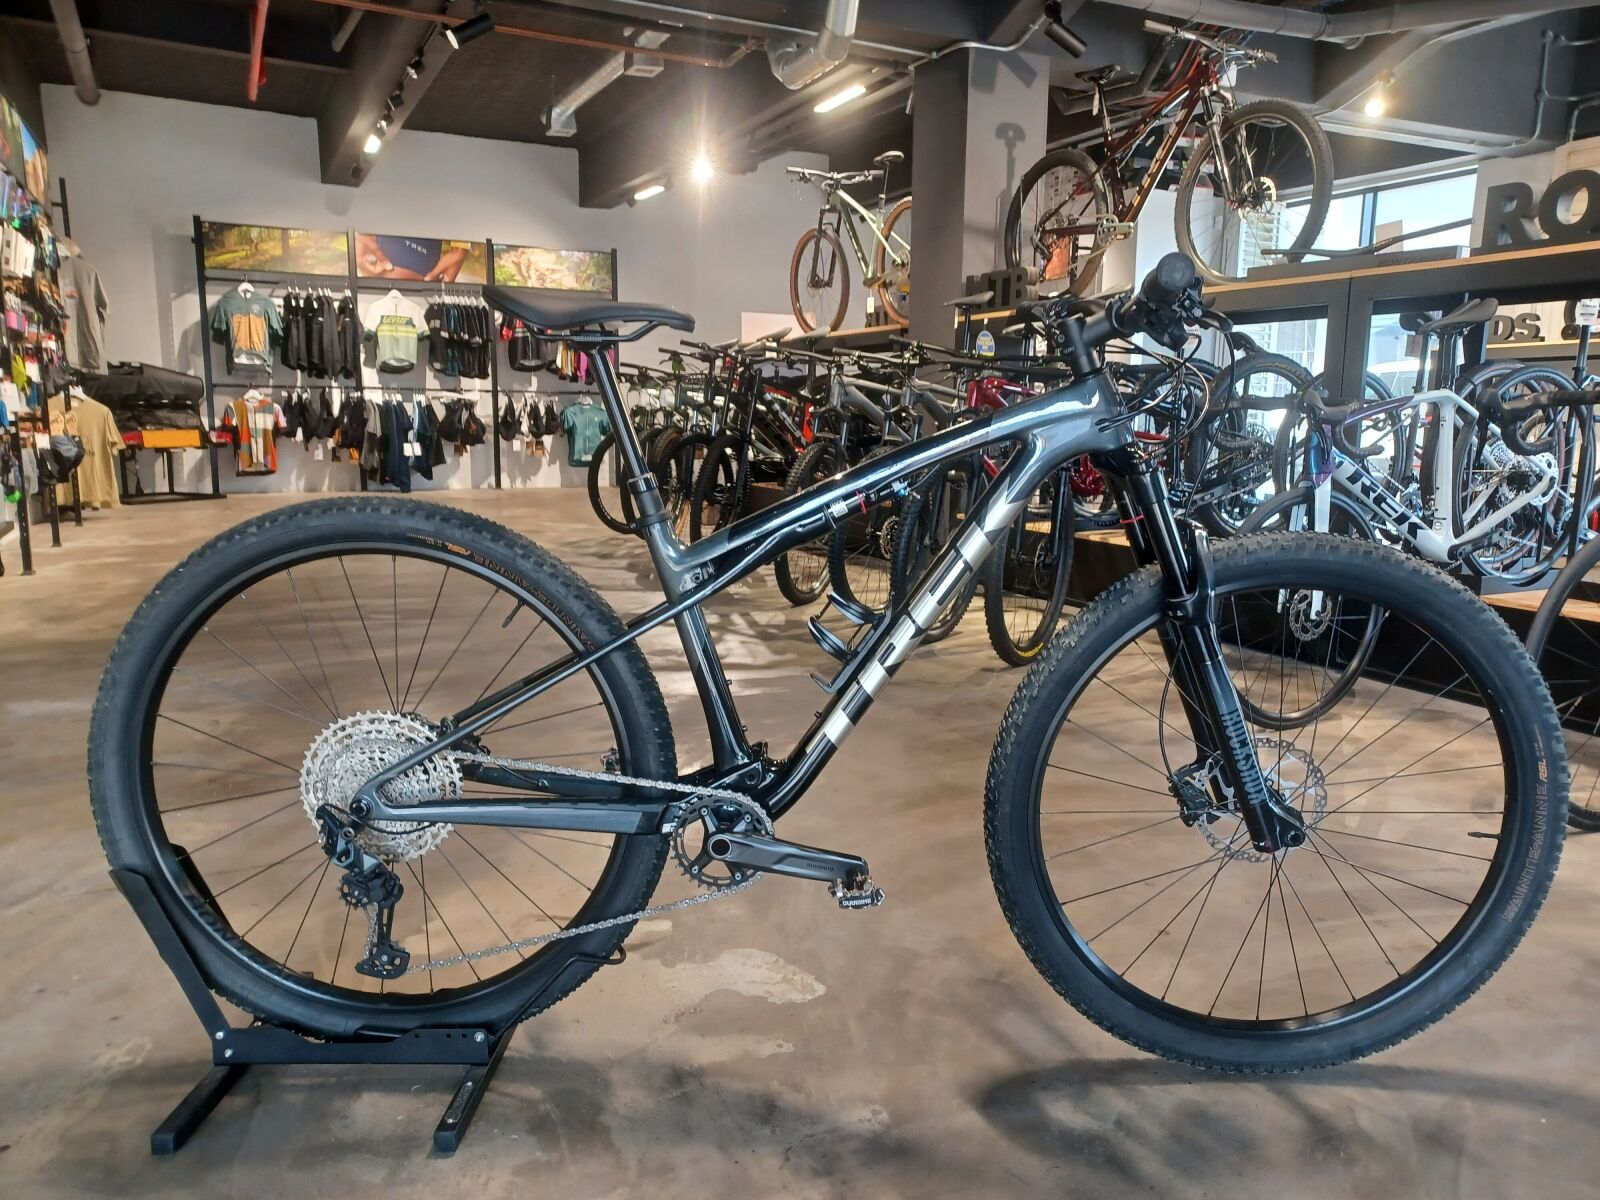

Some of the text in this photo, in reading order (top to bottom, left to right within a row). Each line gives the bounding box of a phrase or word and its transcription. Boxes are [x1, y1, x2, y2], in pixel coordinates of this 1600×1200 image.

[1338, 459, 1426, 541] TREK
[804, 477, 1030, 754] TREK
[1528, 758, 1548, 783] RSL
